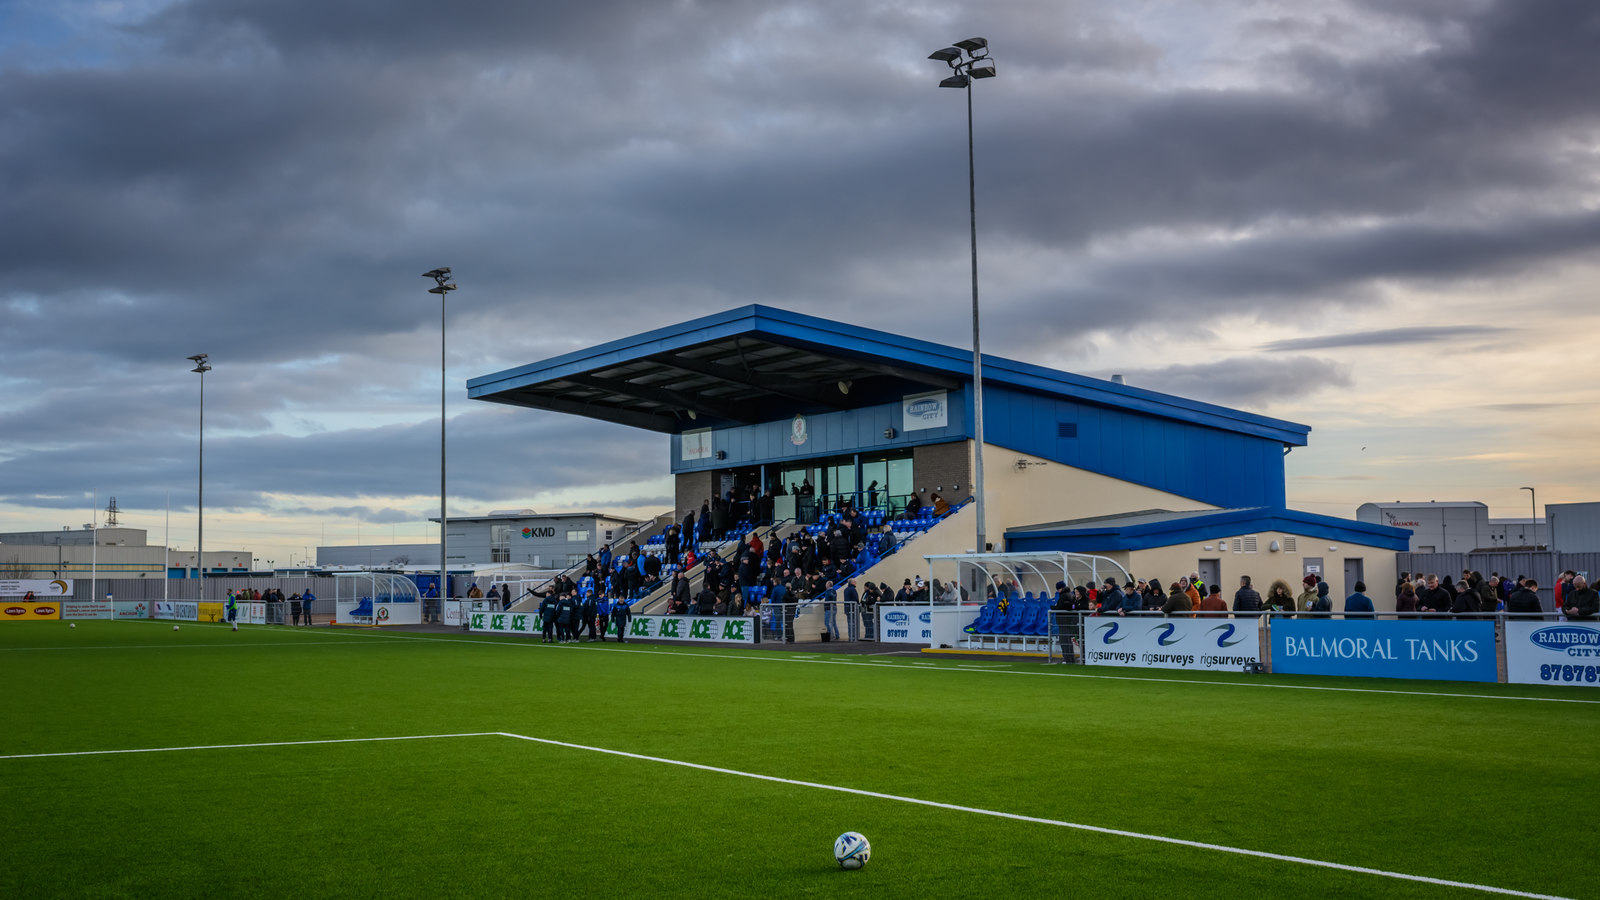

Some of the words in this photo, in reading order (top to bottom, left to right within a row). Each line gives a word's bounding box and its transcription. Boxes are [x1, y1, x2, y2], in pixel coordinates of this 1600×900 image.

[910, 403, 937, 412] RAINBOW
[531, 527, 555, 538] KMD
[470, 613, 484, 630] ACE
[490, 614, 505, 630] ACE
[511, 615, 526, 631] ACE
[630, 617, 649, 636] ACE
[658, 618, 679, 638] ACE
[689, 619, 712, 639] ACE
[721, 620, 746, 640] ACE
[887, 629, 908, 638] 878787
[1538, 632, 1599, 644] RAINBOW
[1088, 649, 1136, 664] rigsurveys
[1285, 636, 1398, 660] BALMORAL
[1404, 638, 1478, 662] TANKS
[1567, 648, 1600, 657] CITY
[1142, 651, 1194, 666] rigsurveys
